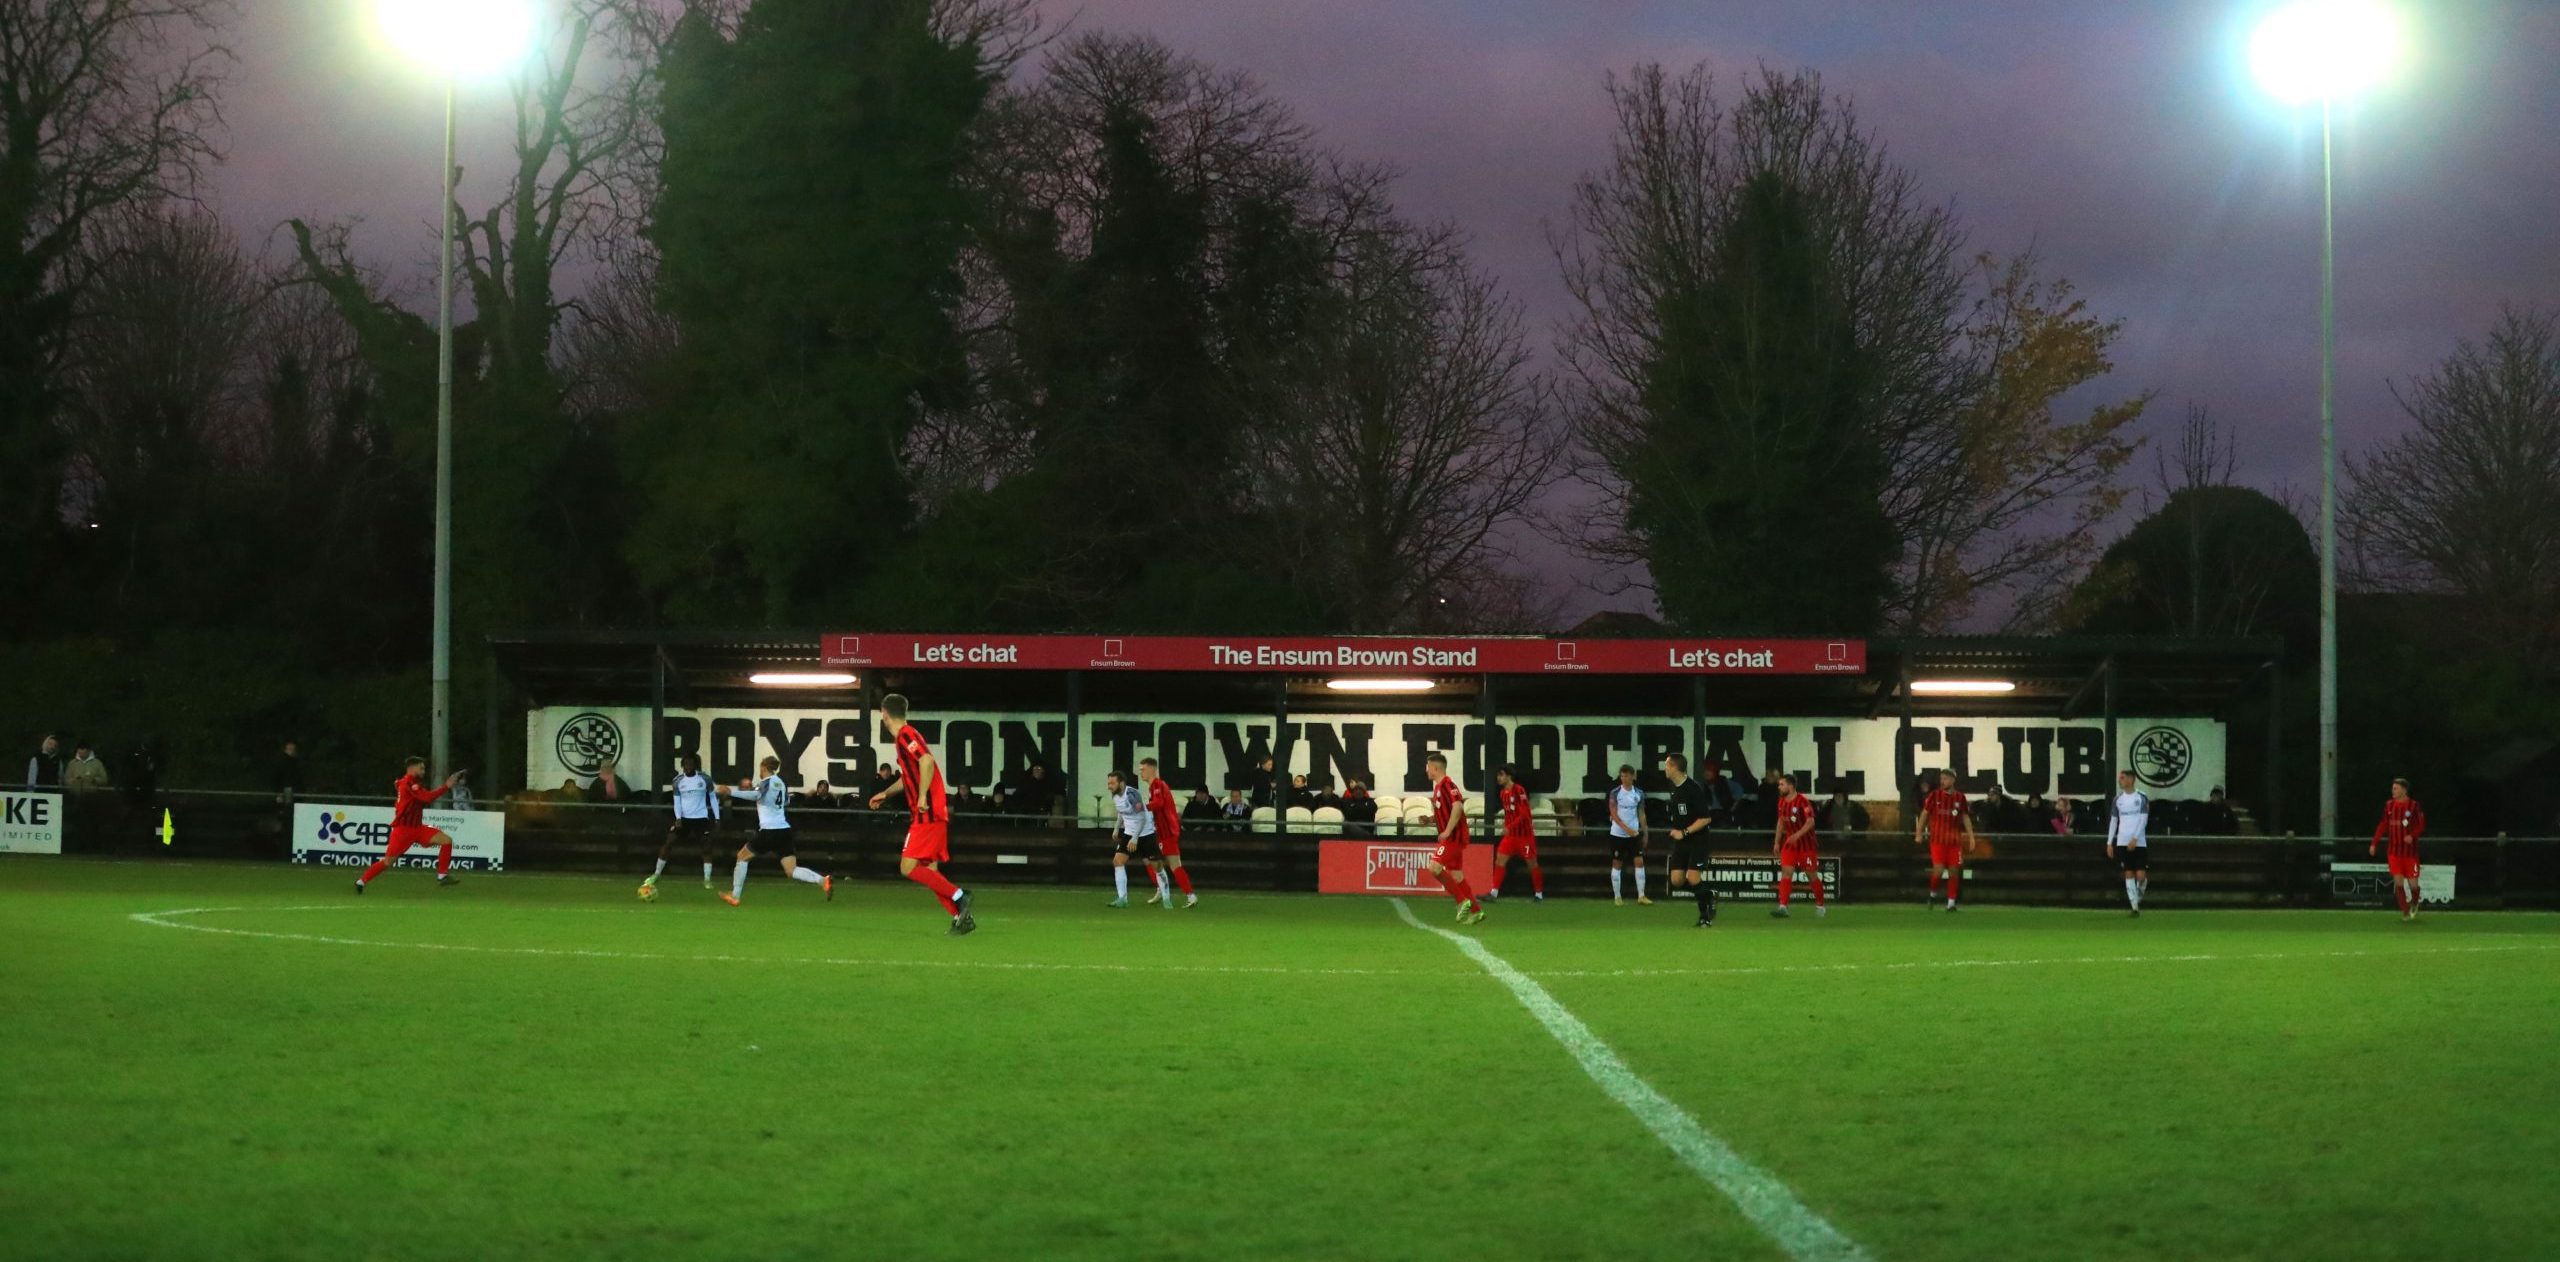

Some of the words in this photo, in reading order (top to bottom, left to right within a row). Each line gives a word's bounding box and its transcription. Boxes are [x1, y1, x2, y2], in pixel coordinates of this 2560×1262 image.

[913, 642, 964, 663] Let's
[968, 643, 1018, 663] chat
[1209, 645, 1253, 665] The
[1256, 645, 1333, 666] Ensum
[1337, 646, 1408, 666] Brown
[1412, 646, 1477, 667] Stand
[1669, 647, 1721, 668] Let's
[1724, 648, 1774, 668] chat
[827, 656, 849, 666] Ensum
[850, 656, 872, 666] Brown
[1090, 659, 1113, 668] Ensum
[1113, 659, 1136, 668] Brown
[1544, 662, 1566, 671] Ensum
[1566, 662, 1589, 671] Brown
[1815, 663, 1837, 671] Ensum
[1838, 664, 1860, 672] Brown
[660, 716, 1066, 790] ROYSON
[1091, 721, 1375, 791] TOWN
[1895, 726, 2106, 796] CLUB
[0, 796, 49, 825] KE
[2, 831, 52, 841] IMITED
[1437, 846, 1445, 856] 8
[1525, 845, 1531, 855] 7
[1404, 867, 1418, 886] IN
[1700, 870, 1774, 882] NLIMITED
